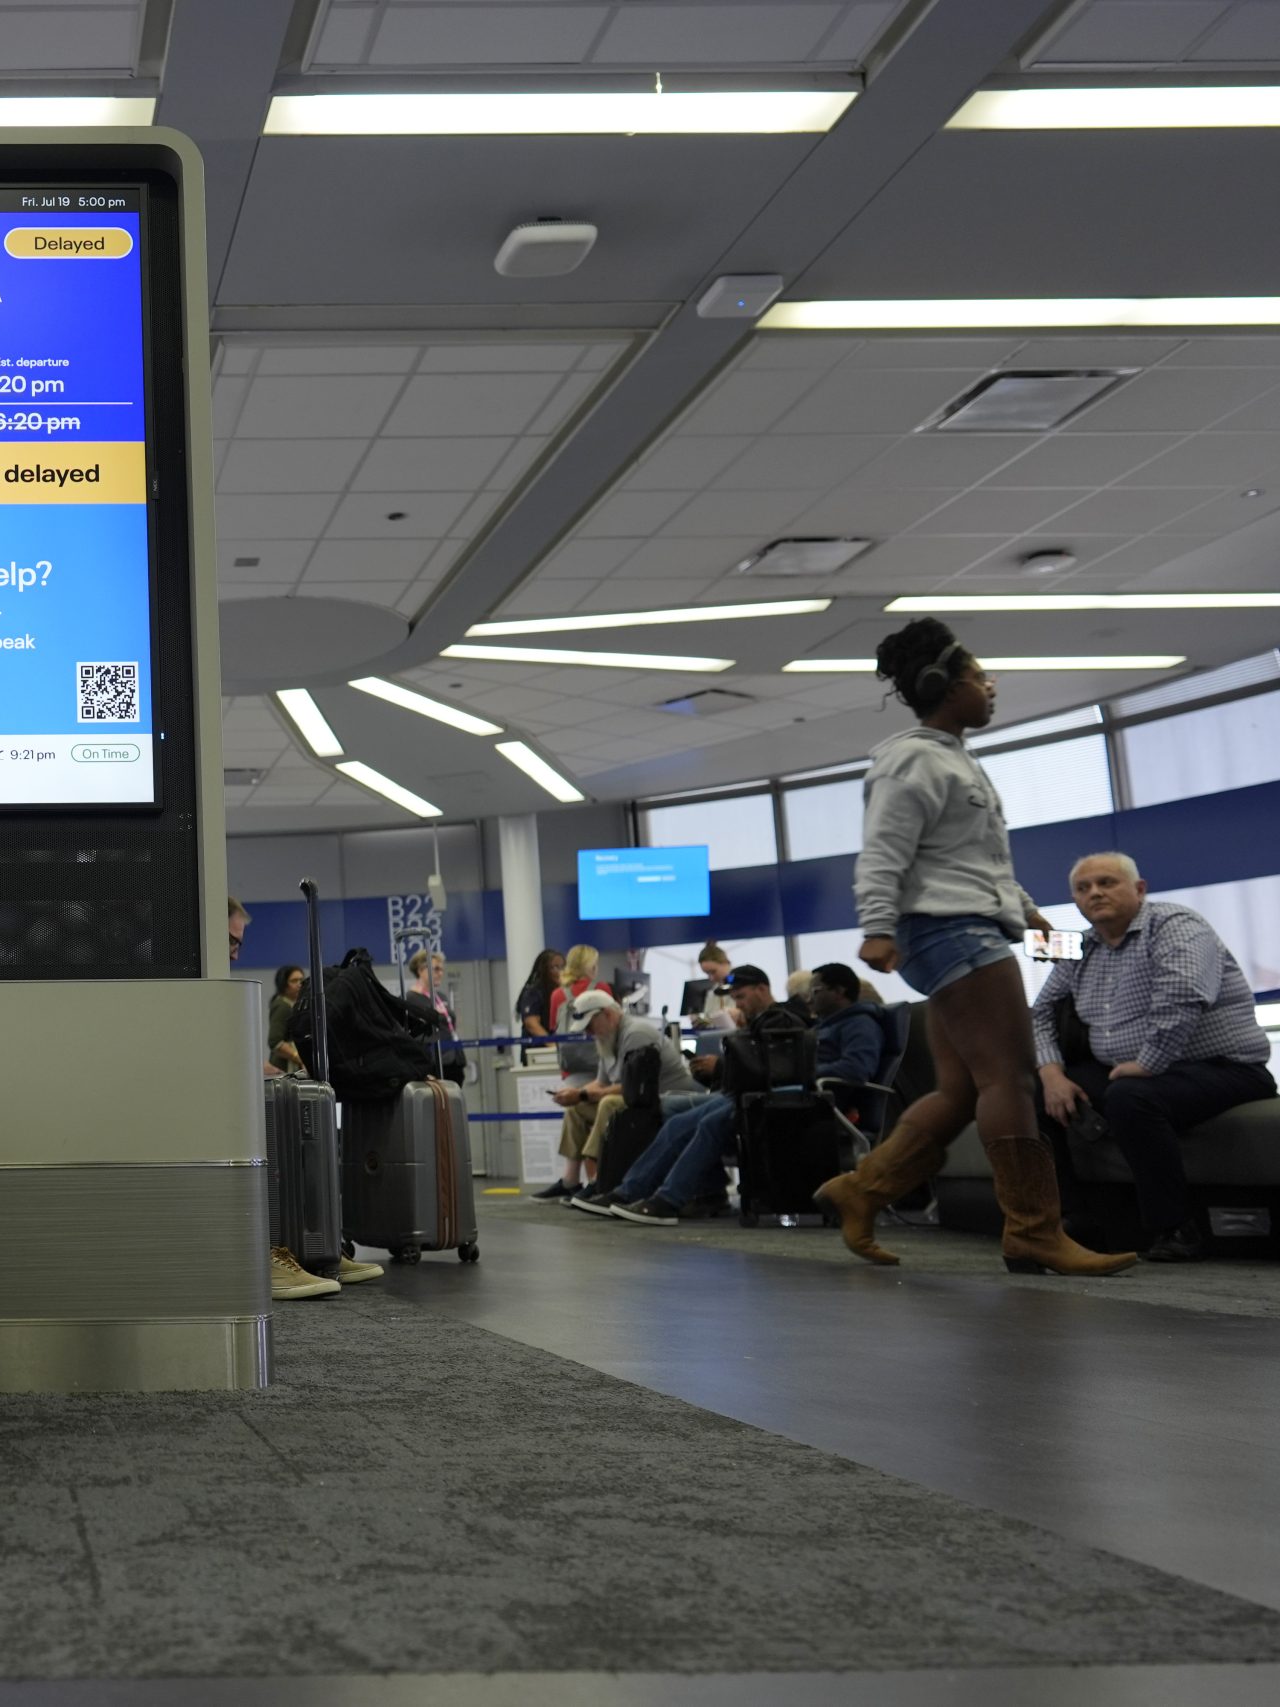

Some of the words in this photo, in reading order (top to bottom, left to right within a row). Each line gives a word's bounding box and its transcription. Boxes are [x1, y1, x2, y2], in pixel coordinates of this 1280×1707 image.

[22, 196, 39, 207] Fri.
[40, 196, 56, 207] Jul
[57, 196, 71, 207] 19
[78, 196, 106, 207] 5:00
[108, 199, 126, 209] pm
[34, 236, 105, 254] Delayed
[15, 356, 70, 369] departure
[31, 379, 65, 397] pm
[45, 416, 81, 434] pm
[4, 463, 100, 488] delayed
[10, 749, 34, 760] 9:21
[36, 751, 56, 762] pm
[82, 748, 99, 760] On
[102, 748, 129, 760] Time
